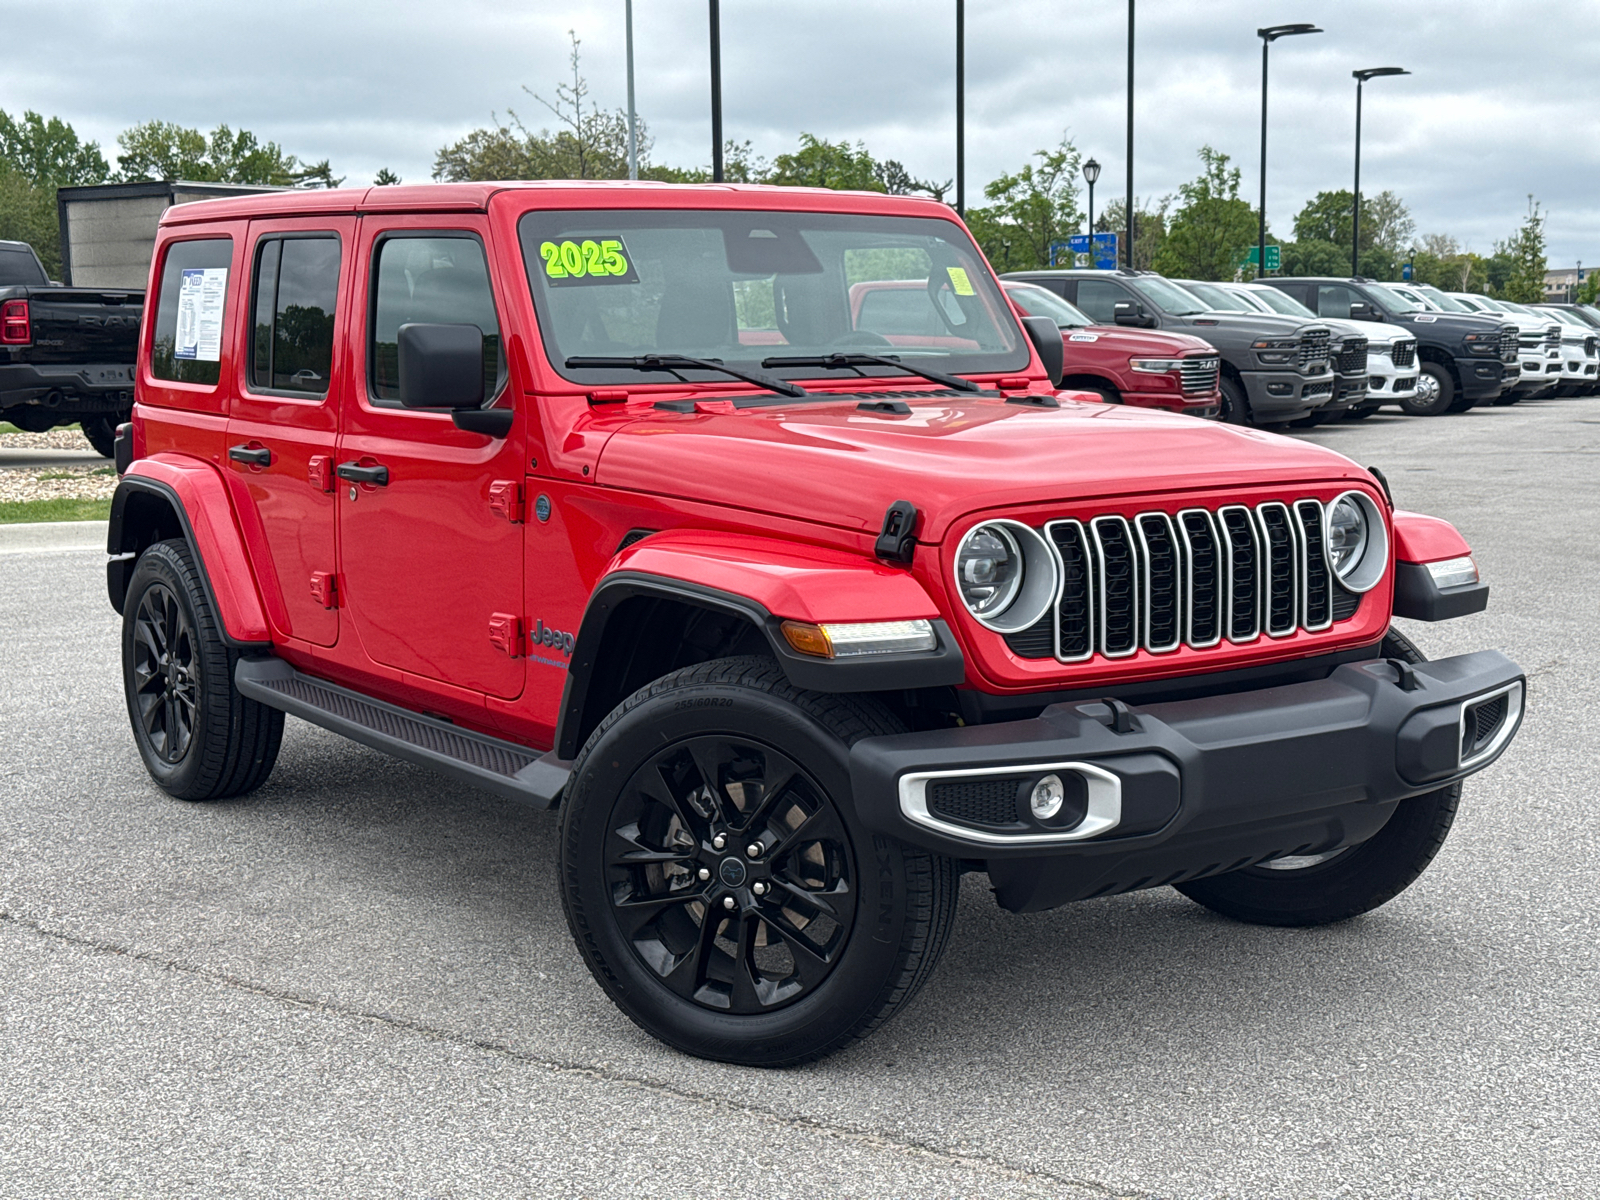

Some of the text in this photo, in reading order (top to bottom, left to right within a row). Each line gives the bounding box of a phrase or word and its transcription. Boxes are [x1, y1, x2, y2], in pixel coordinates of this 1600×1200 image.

[540, 240, 628, 278] 2025
[79, 314, 143, 327] RAM
[530, 618, 575, 657] Jeep
[674, 697, 733, 711] 255/60R20
[872, 834, 893, 925] EXEN
[566, 863, 618, 982] ROADIAN
